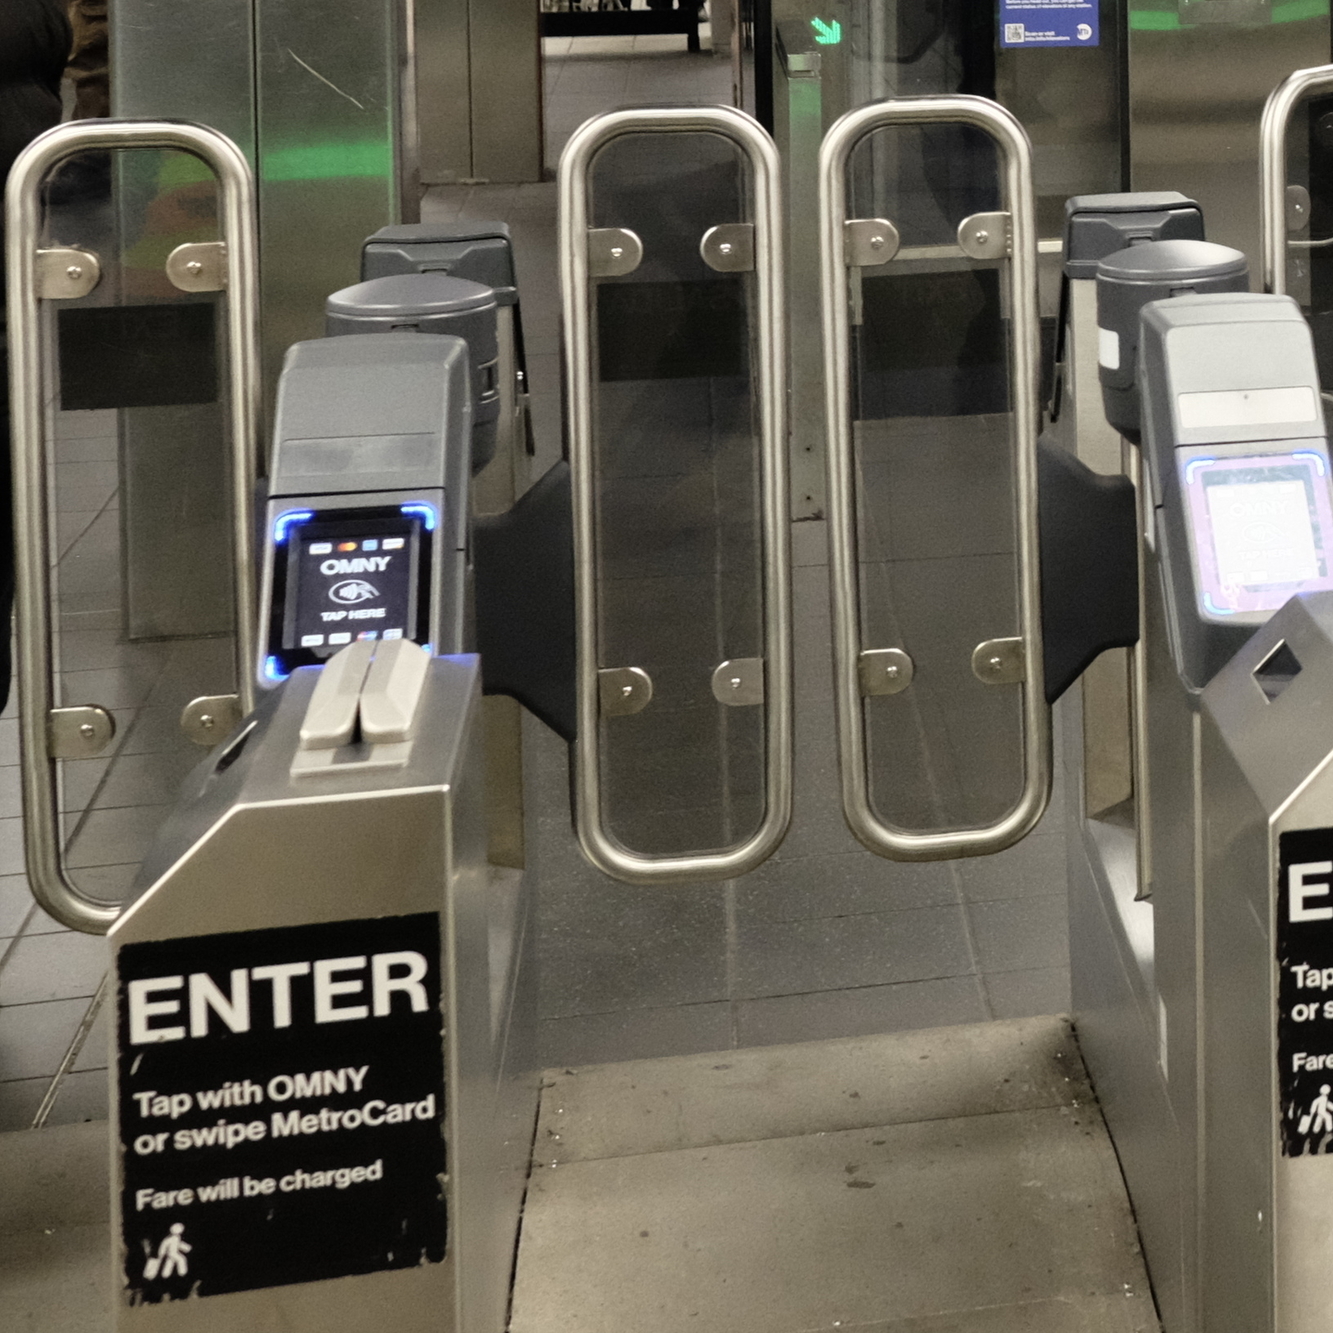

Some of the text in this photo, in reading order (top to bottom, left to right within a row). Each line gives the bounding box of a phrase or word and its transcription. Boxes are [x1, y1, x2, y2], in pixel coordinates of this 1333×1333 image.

[320, 556, 392, 575] OMNY
[320, 608, 386, 622] TAP HERE
[128, 951, 429, 1045] ENTER
[1291, 999, 1319, 1023] or
[133, 1066, 369, 1120] Tap with OMNY
[134, 1096, 436, 1155] or swipe MetroCard
[136, 1160, 383, 1212] Fare will be charged
